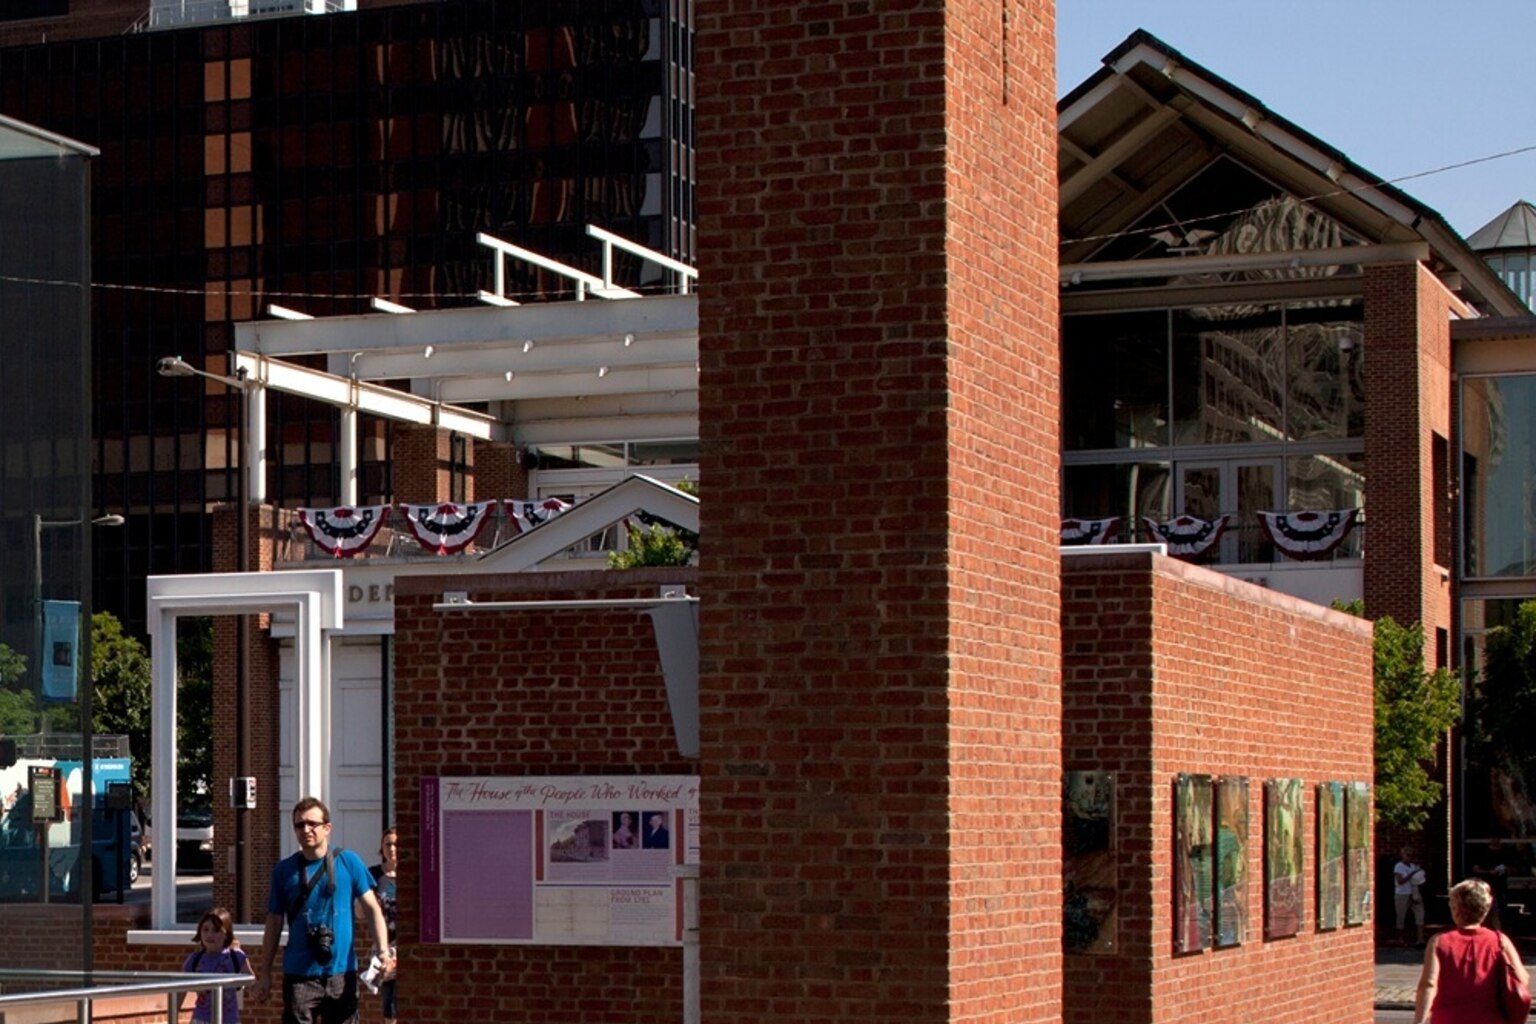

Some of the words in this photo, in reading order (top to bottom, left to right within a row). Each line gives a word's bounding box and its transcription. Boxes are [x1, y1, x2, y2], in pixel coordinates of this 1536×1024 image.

[445, 782, 465, 802] The
[470, 780, 513, 803] House
[540, 784, 587, 805] People
[591, 782, 622, 800] Who
[628, 780, 684, 802] Worked
